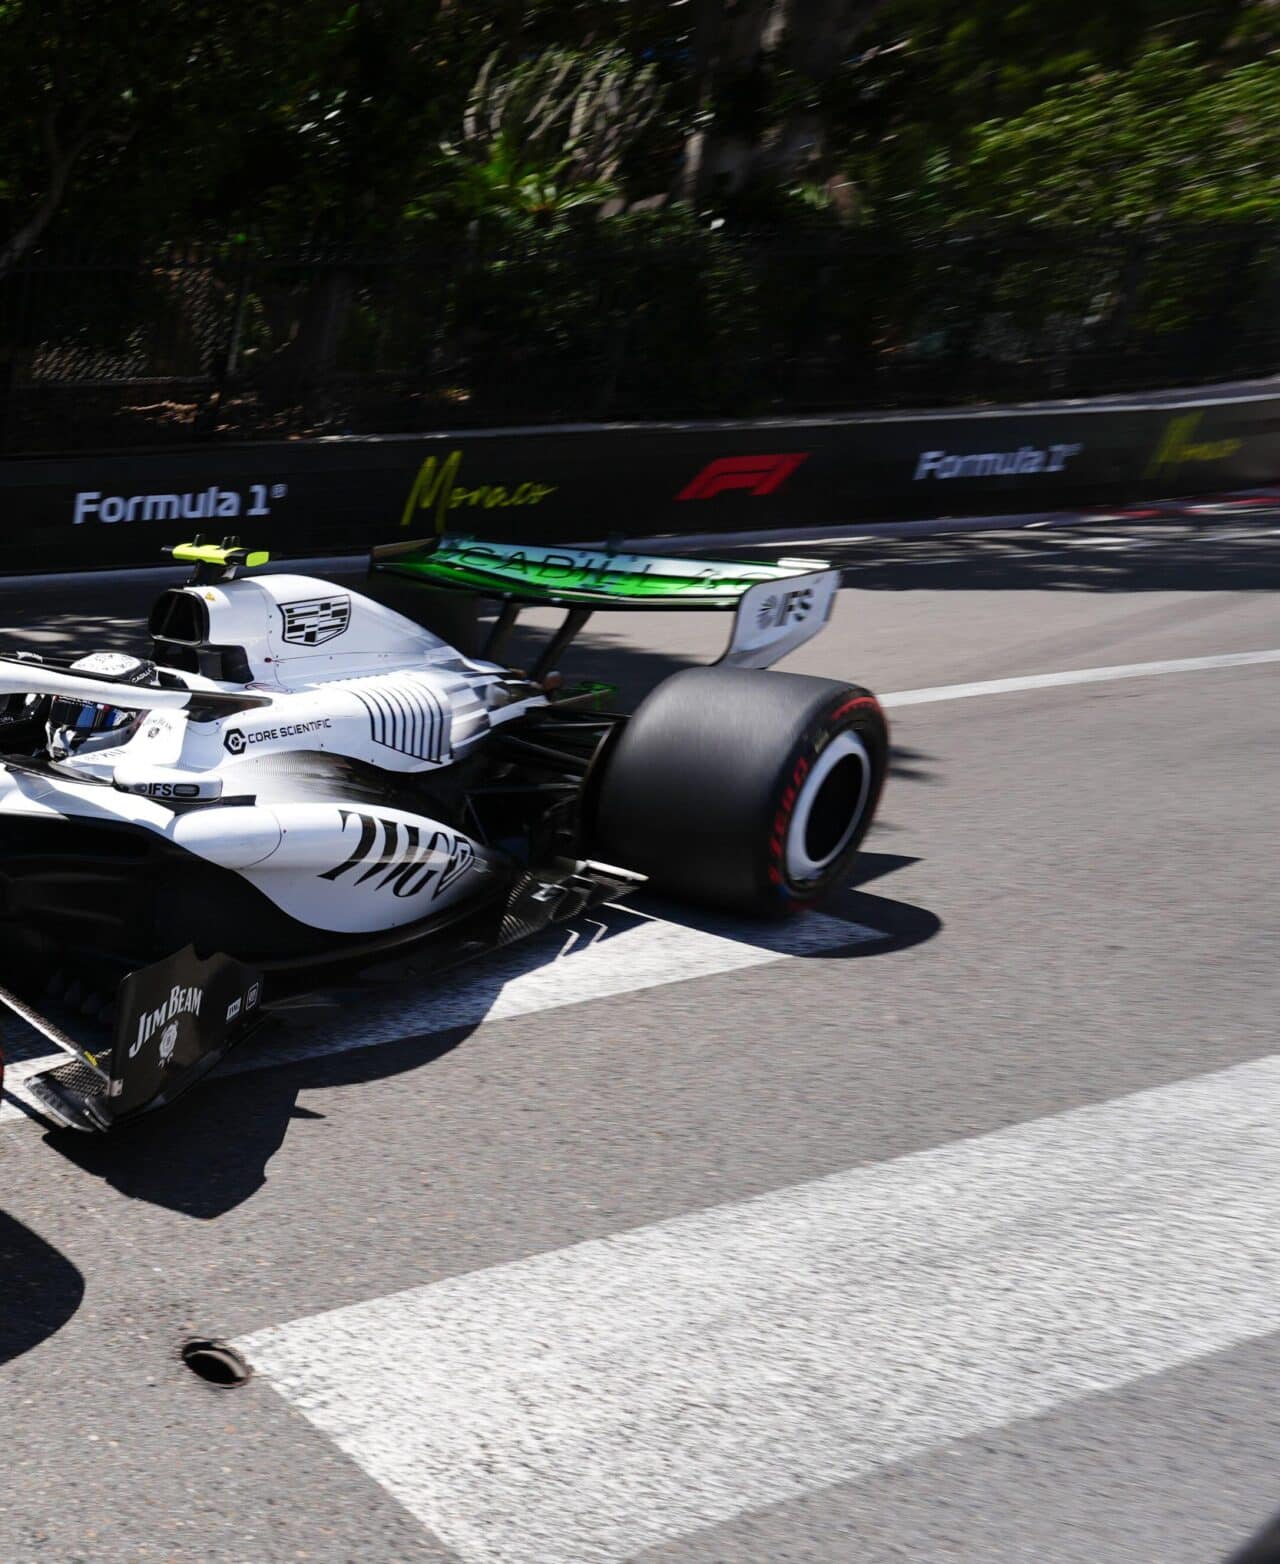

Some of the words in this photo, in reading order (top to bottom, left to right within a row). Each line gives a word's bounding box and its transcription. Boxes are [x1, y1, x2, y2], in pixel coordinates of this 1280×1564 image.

[72, 486, 241, 524] Formula
[248, 729, 278, 744] CORE
[280, 718, 332, 738] SCIENTIFIC
[148, 783, 172, 798] IFS
[128, 1001, 169, 1058] JIM
[167, 985, 202, 1020] BEAM
